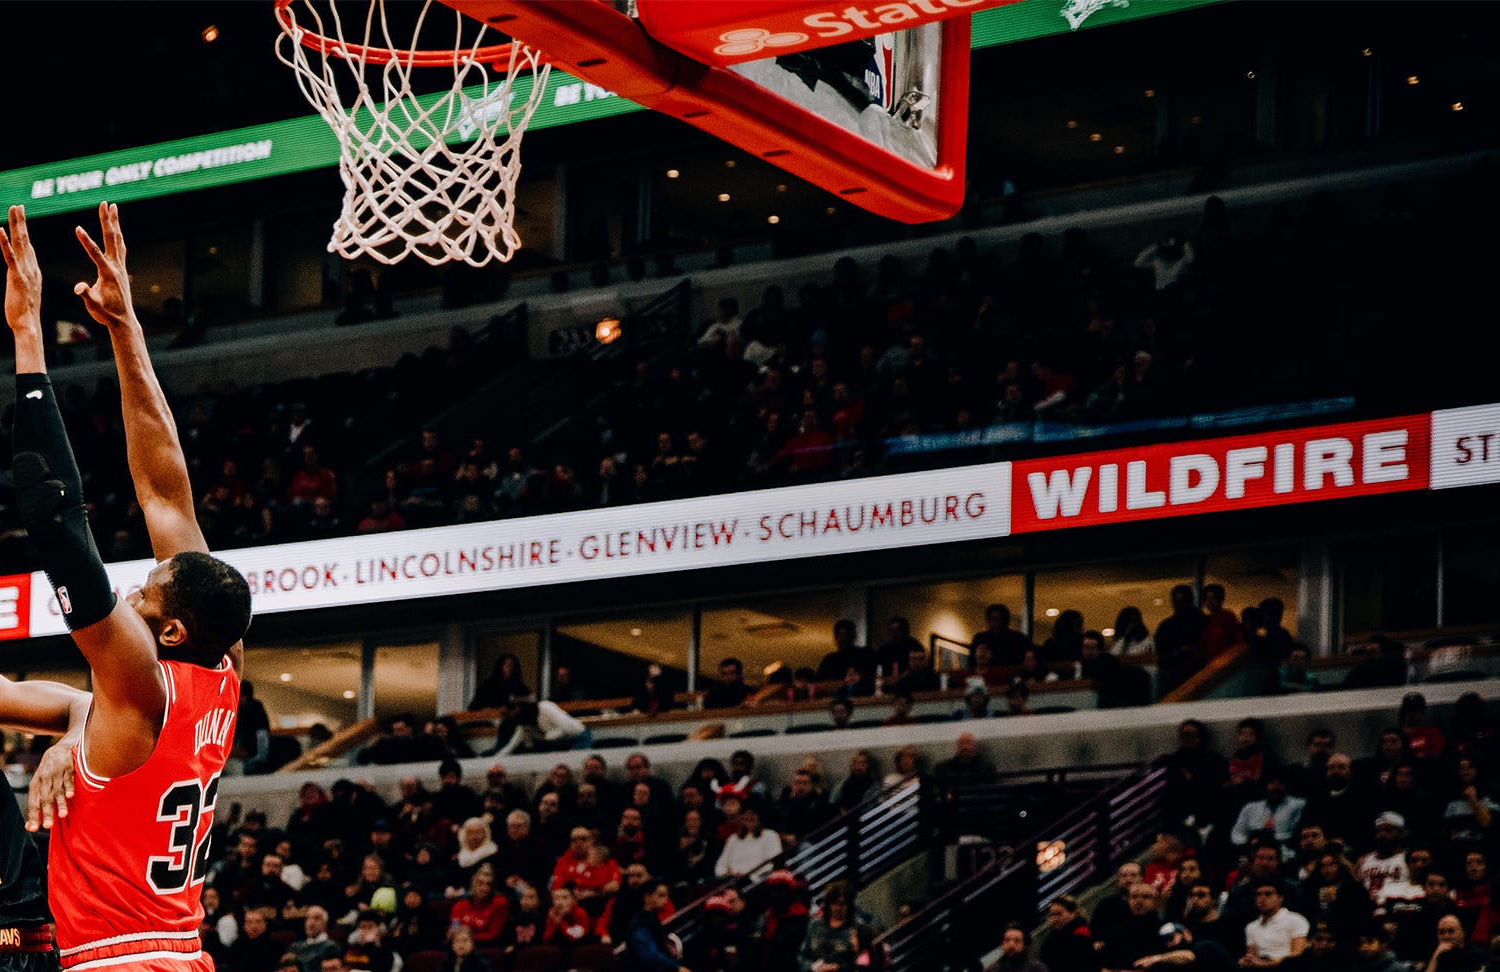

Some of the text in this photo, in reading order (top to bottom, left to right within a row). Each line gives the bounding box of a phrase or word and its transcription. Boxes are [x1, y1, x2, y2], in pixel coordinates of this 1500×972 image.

[1027, 429, 1496, 520] WILDFIRE ST
[355, 540, 560, 585] LINCOLNSHIRE
[580, 518, 738, 562] GLENVIEW
[759, 492, 986, 542] SCHAUMBURG
